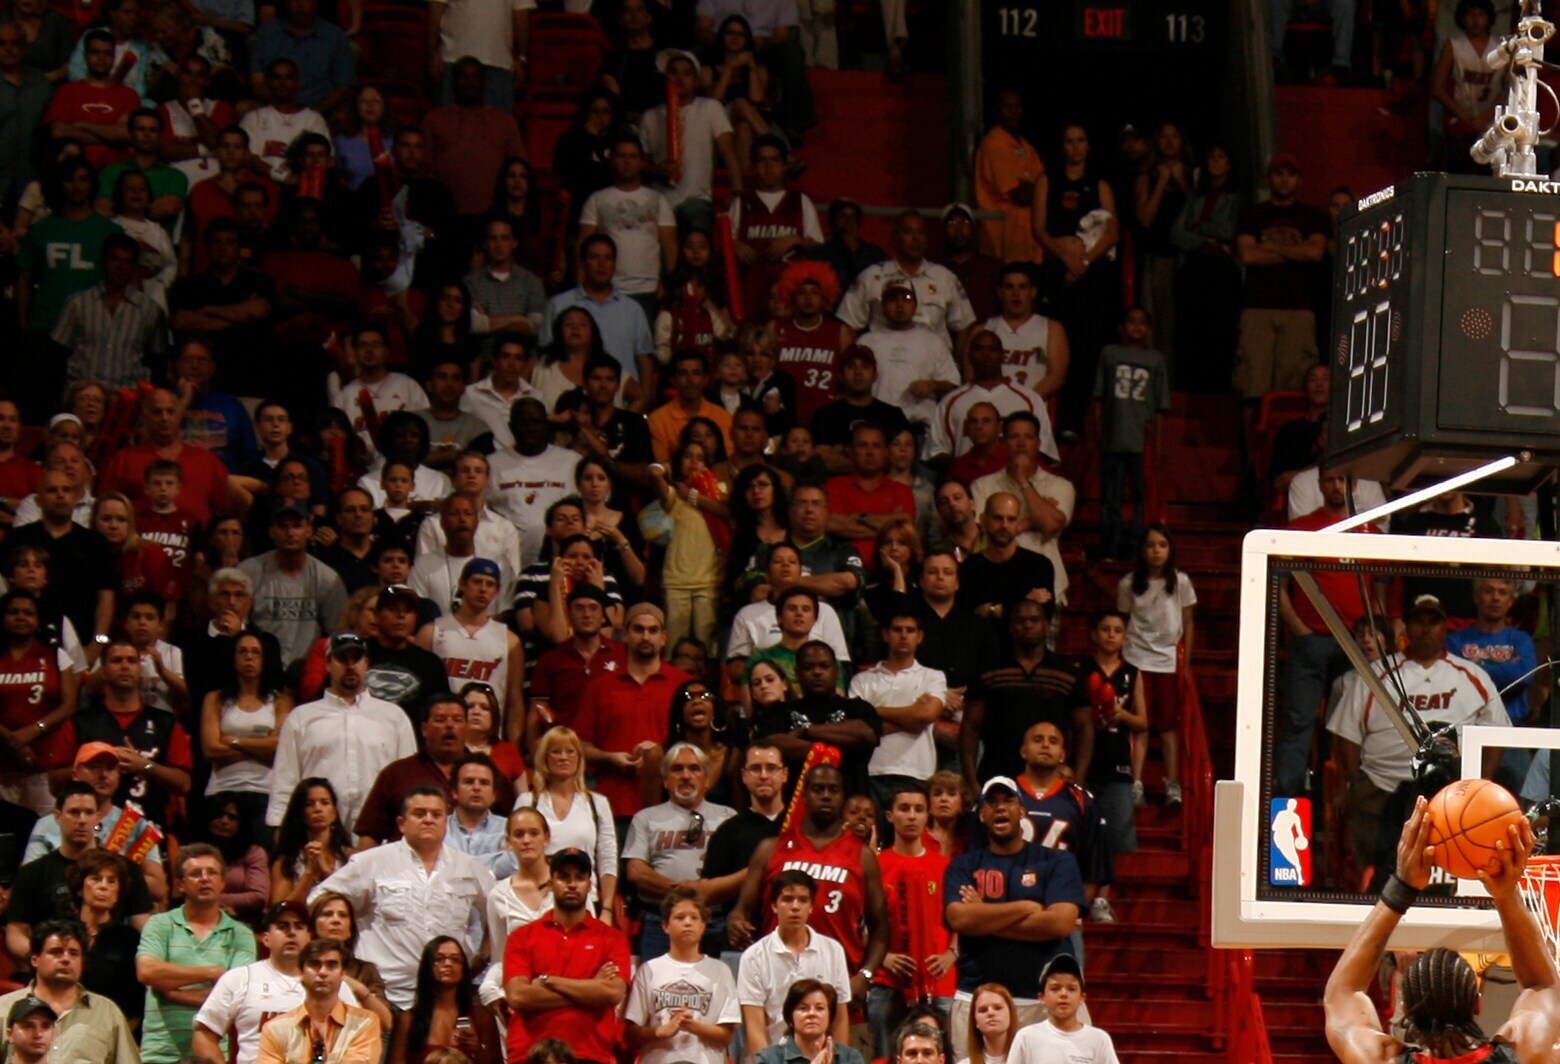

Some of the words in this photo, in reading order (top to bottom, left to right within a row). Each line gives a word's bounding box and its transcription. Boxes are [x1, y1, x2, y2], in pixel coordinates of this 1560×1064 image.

[999, 7, 1037, 37] 112
[1082, 7, 1124, 37] EXIT
[1166, 13, 1205, 43] 113
[45, 240, 96, 271] FL
[779, 346, 834, 366] MIAMI
[806, 368, 832, 392] 32
[28, 684, 45, 705] 3
[1399, 687, 1459, 713] HEAT
[782, 860, 849, 885] MIAMI
[971, 868, 1005, 899] 10
[1274, 867, 1298, 881] NBA
[823, 889, 843, 914] 3
